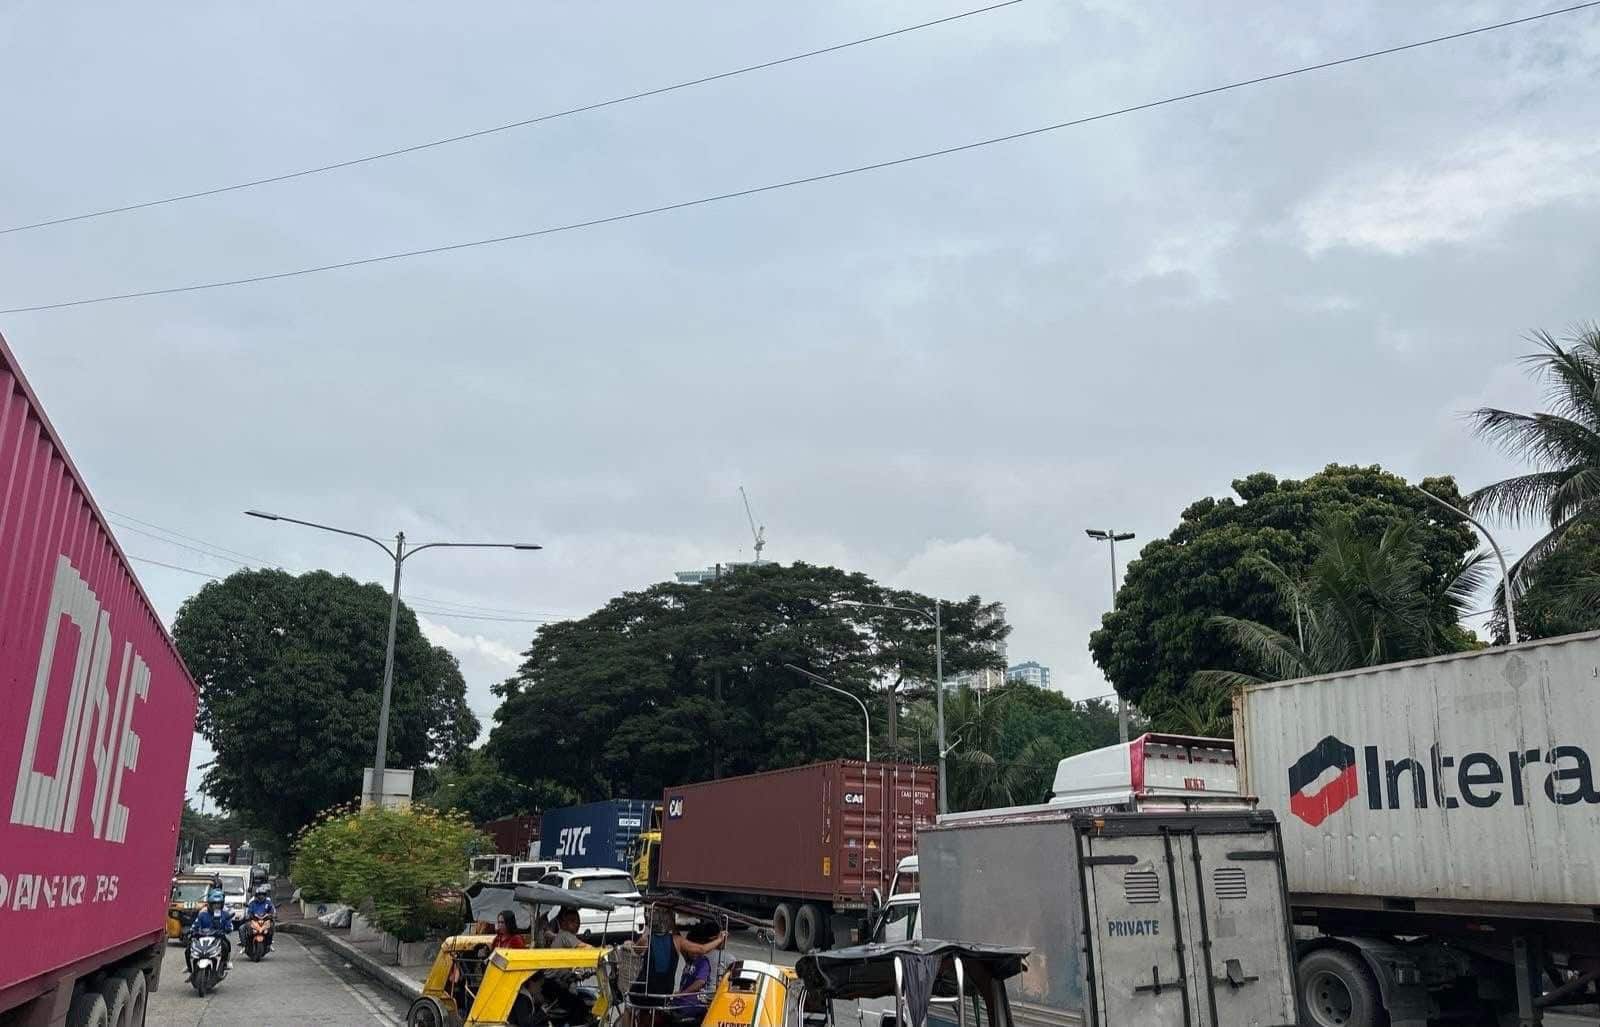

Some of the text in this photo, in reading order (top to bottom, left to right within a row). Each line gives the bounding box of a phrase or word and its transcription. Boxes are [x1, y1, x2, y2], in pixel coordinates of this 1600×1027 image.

[1364, 741, 1600, 810] Intera
[845, 793, 863, 804] CAI
[669, 799, 684, 817] CAI
[555, 826, 591, 856] SITC
[1108, 920, 1160, 937] PRIVATE
